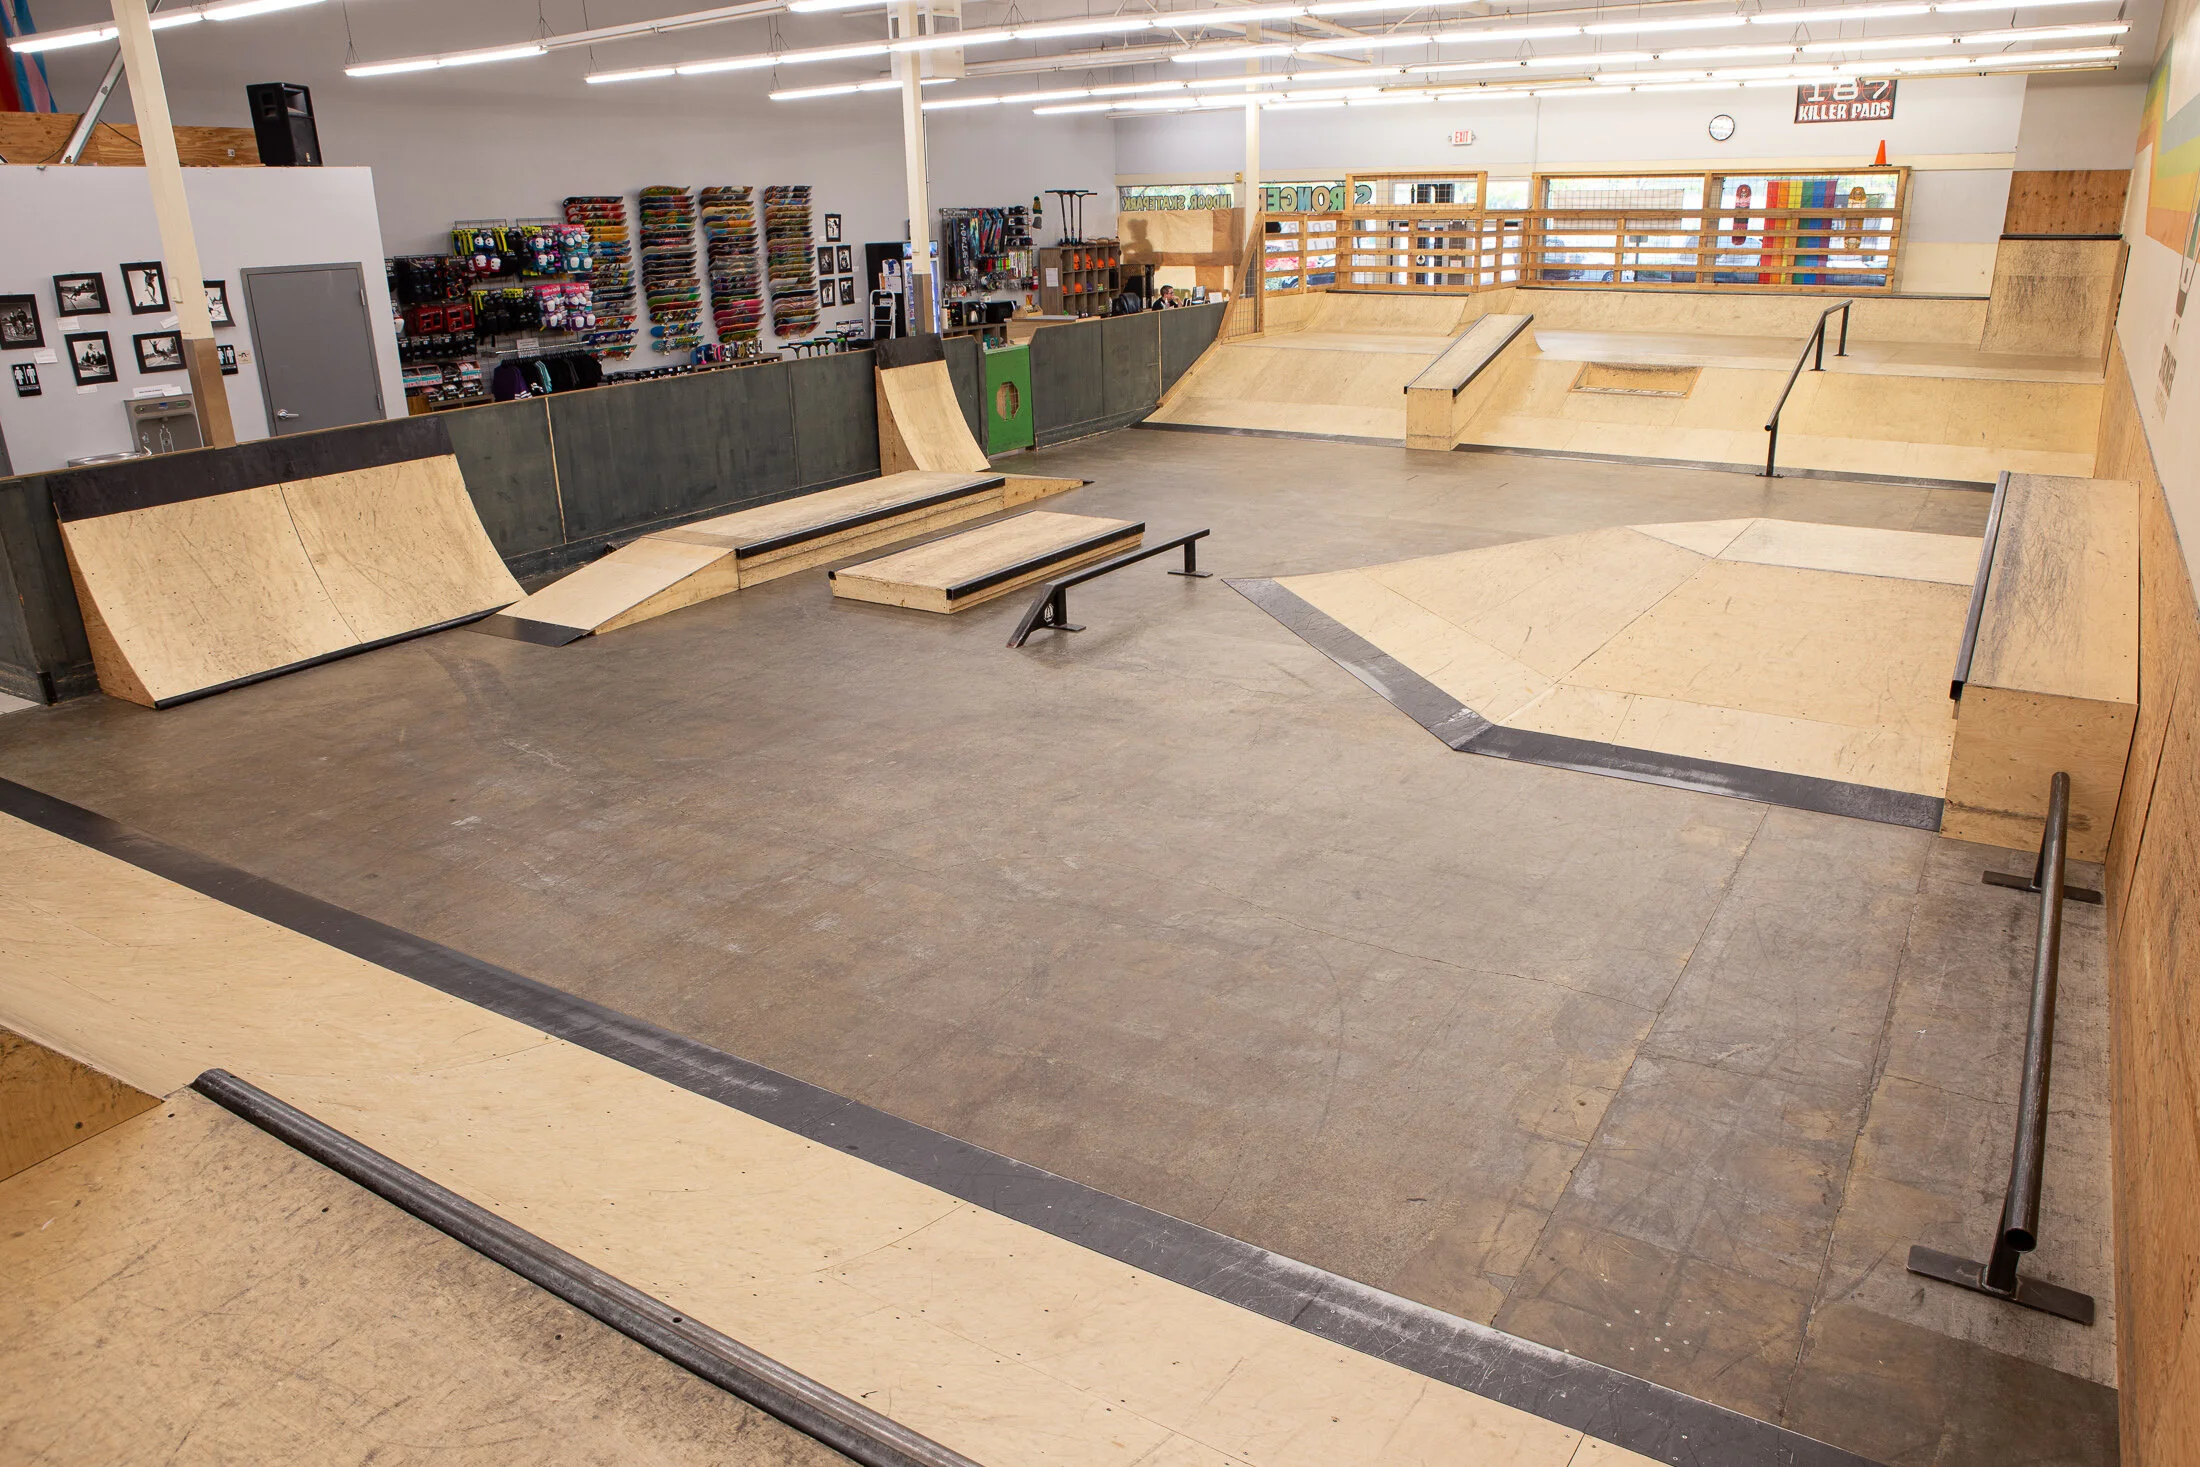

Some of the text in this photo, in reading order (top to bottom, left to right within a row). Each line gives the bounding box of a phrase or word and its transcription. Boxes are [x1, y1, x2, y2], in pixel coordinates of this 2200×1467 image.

[1807, 80, 1891, 102] 187
[1799, 101, 1890, 120] KILLER PADS
[1455, 130, 1469, 143] EXIT
